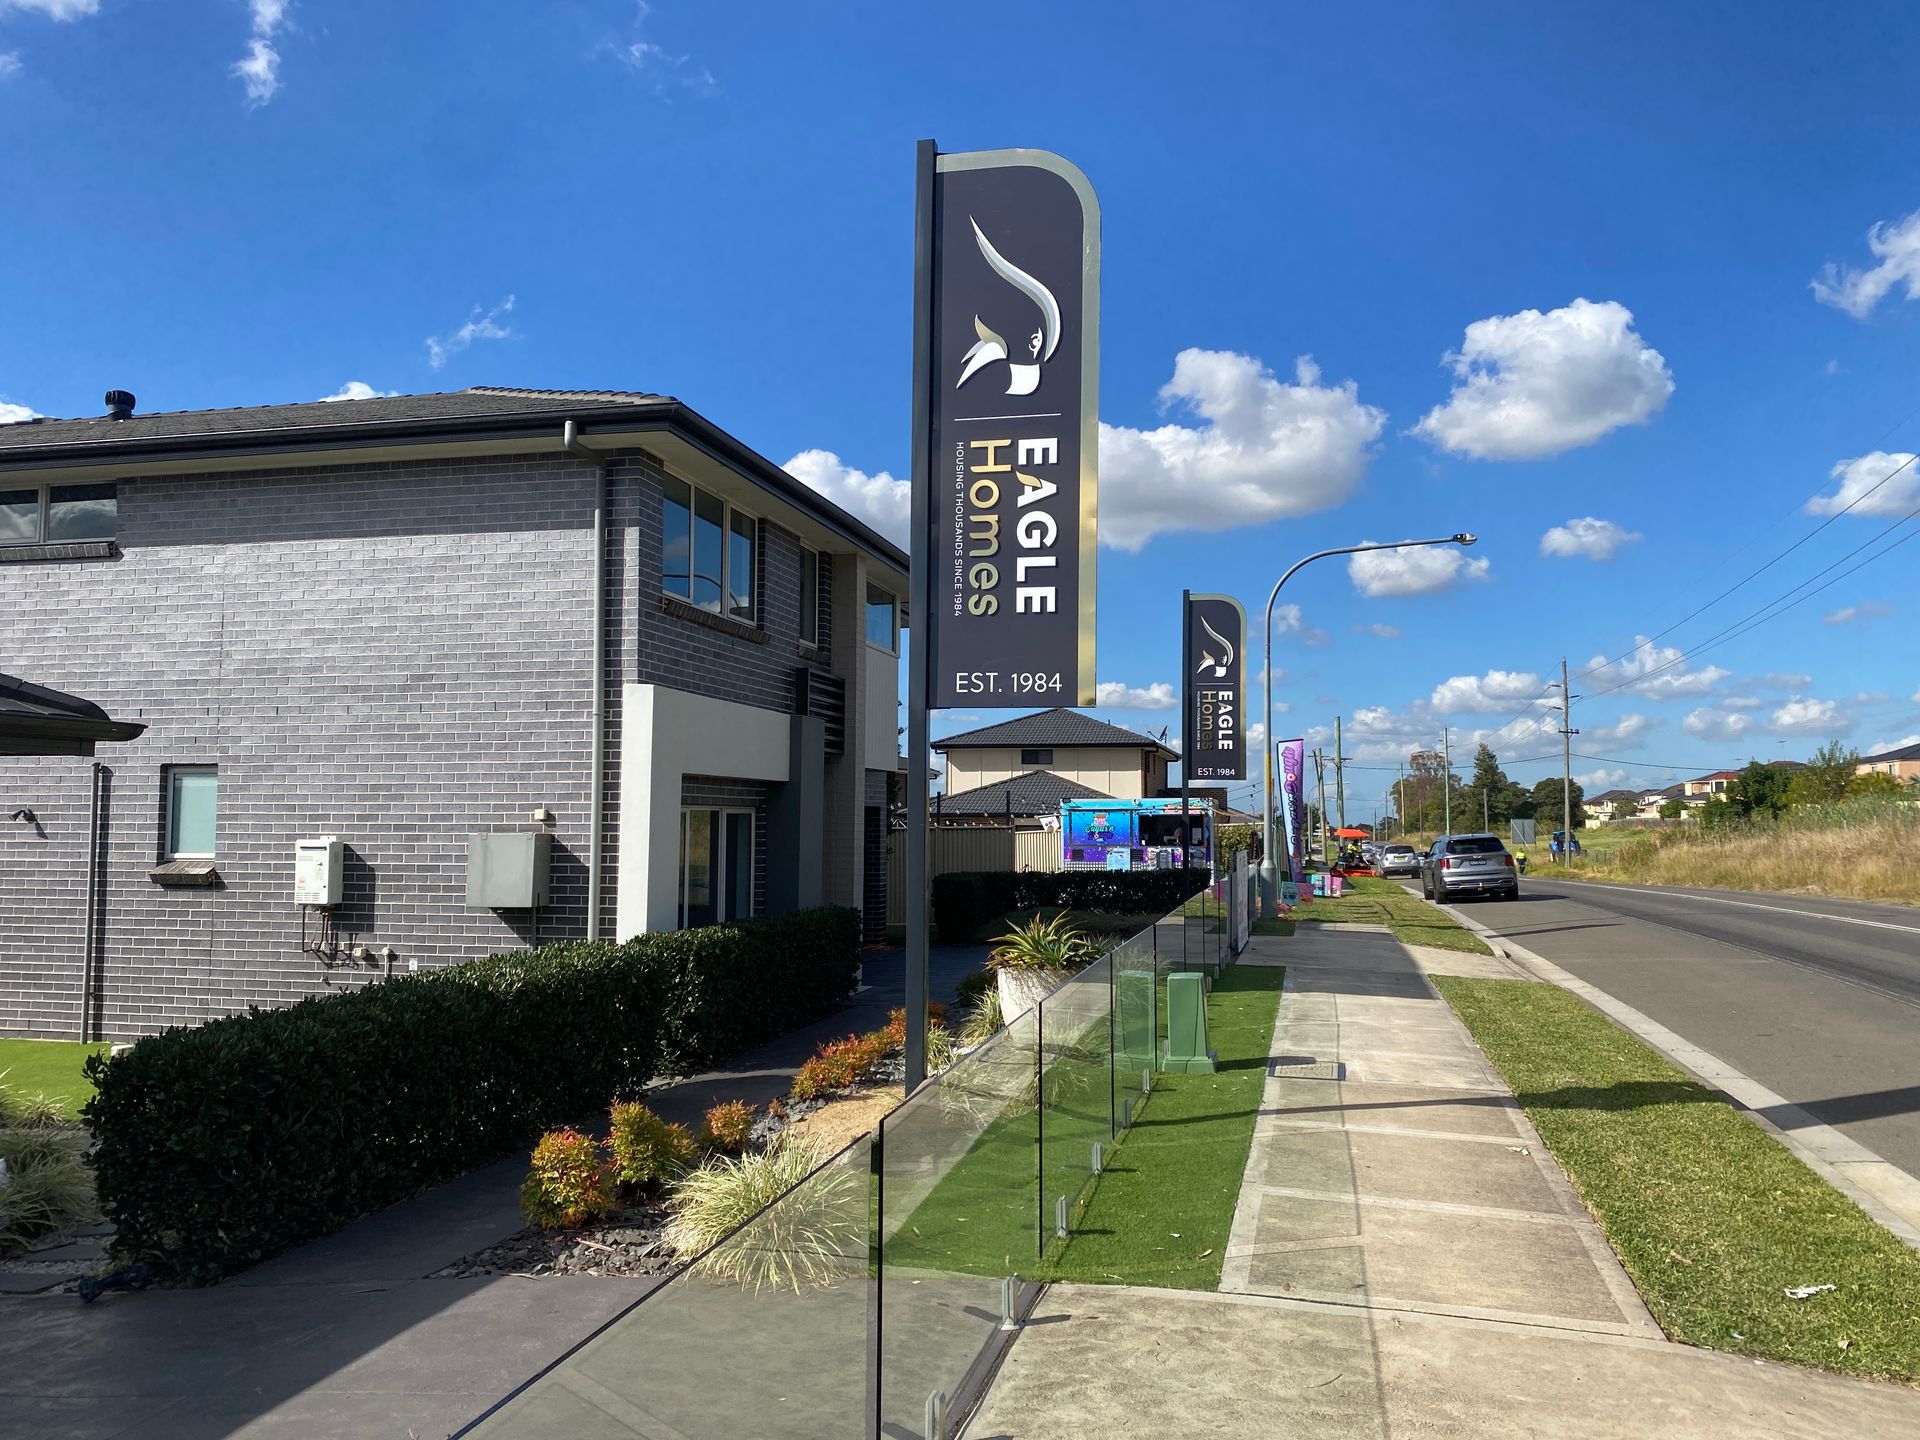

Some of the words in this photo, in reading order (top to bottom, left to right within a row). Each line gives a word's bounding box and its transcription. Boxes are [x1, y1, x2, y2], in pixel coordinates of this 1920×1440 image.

[956, 442, 964, 490] HOUSING
[955, 491, 964, 557] THOUSANDS
[968, 439, 1012, 616] Homes
[1015, 437, 1058, 614] EAGLE
[954, 558, 963, 590] SINCE
[954, 592, 962, 617] 1984
[955, 672, 1003, 693] EST.
[1010, 672, 1063, 693] 1984
[1201, 690, 1217, 750] Homes
[1218, 690, 1233, 750] EAGLE
[1197, 767, 1215, 776] EST.
[1217, 767, 1236, 776] 1984
